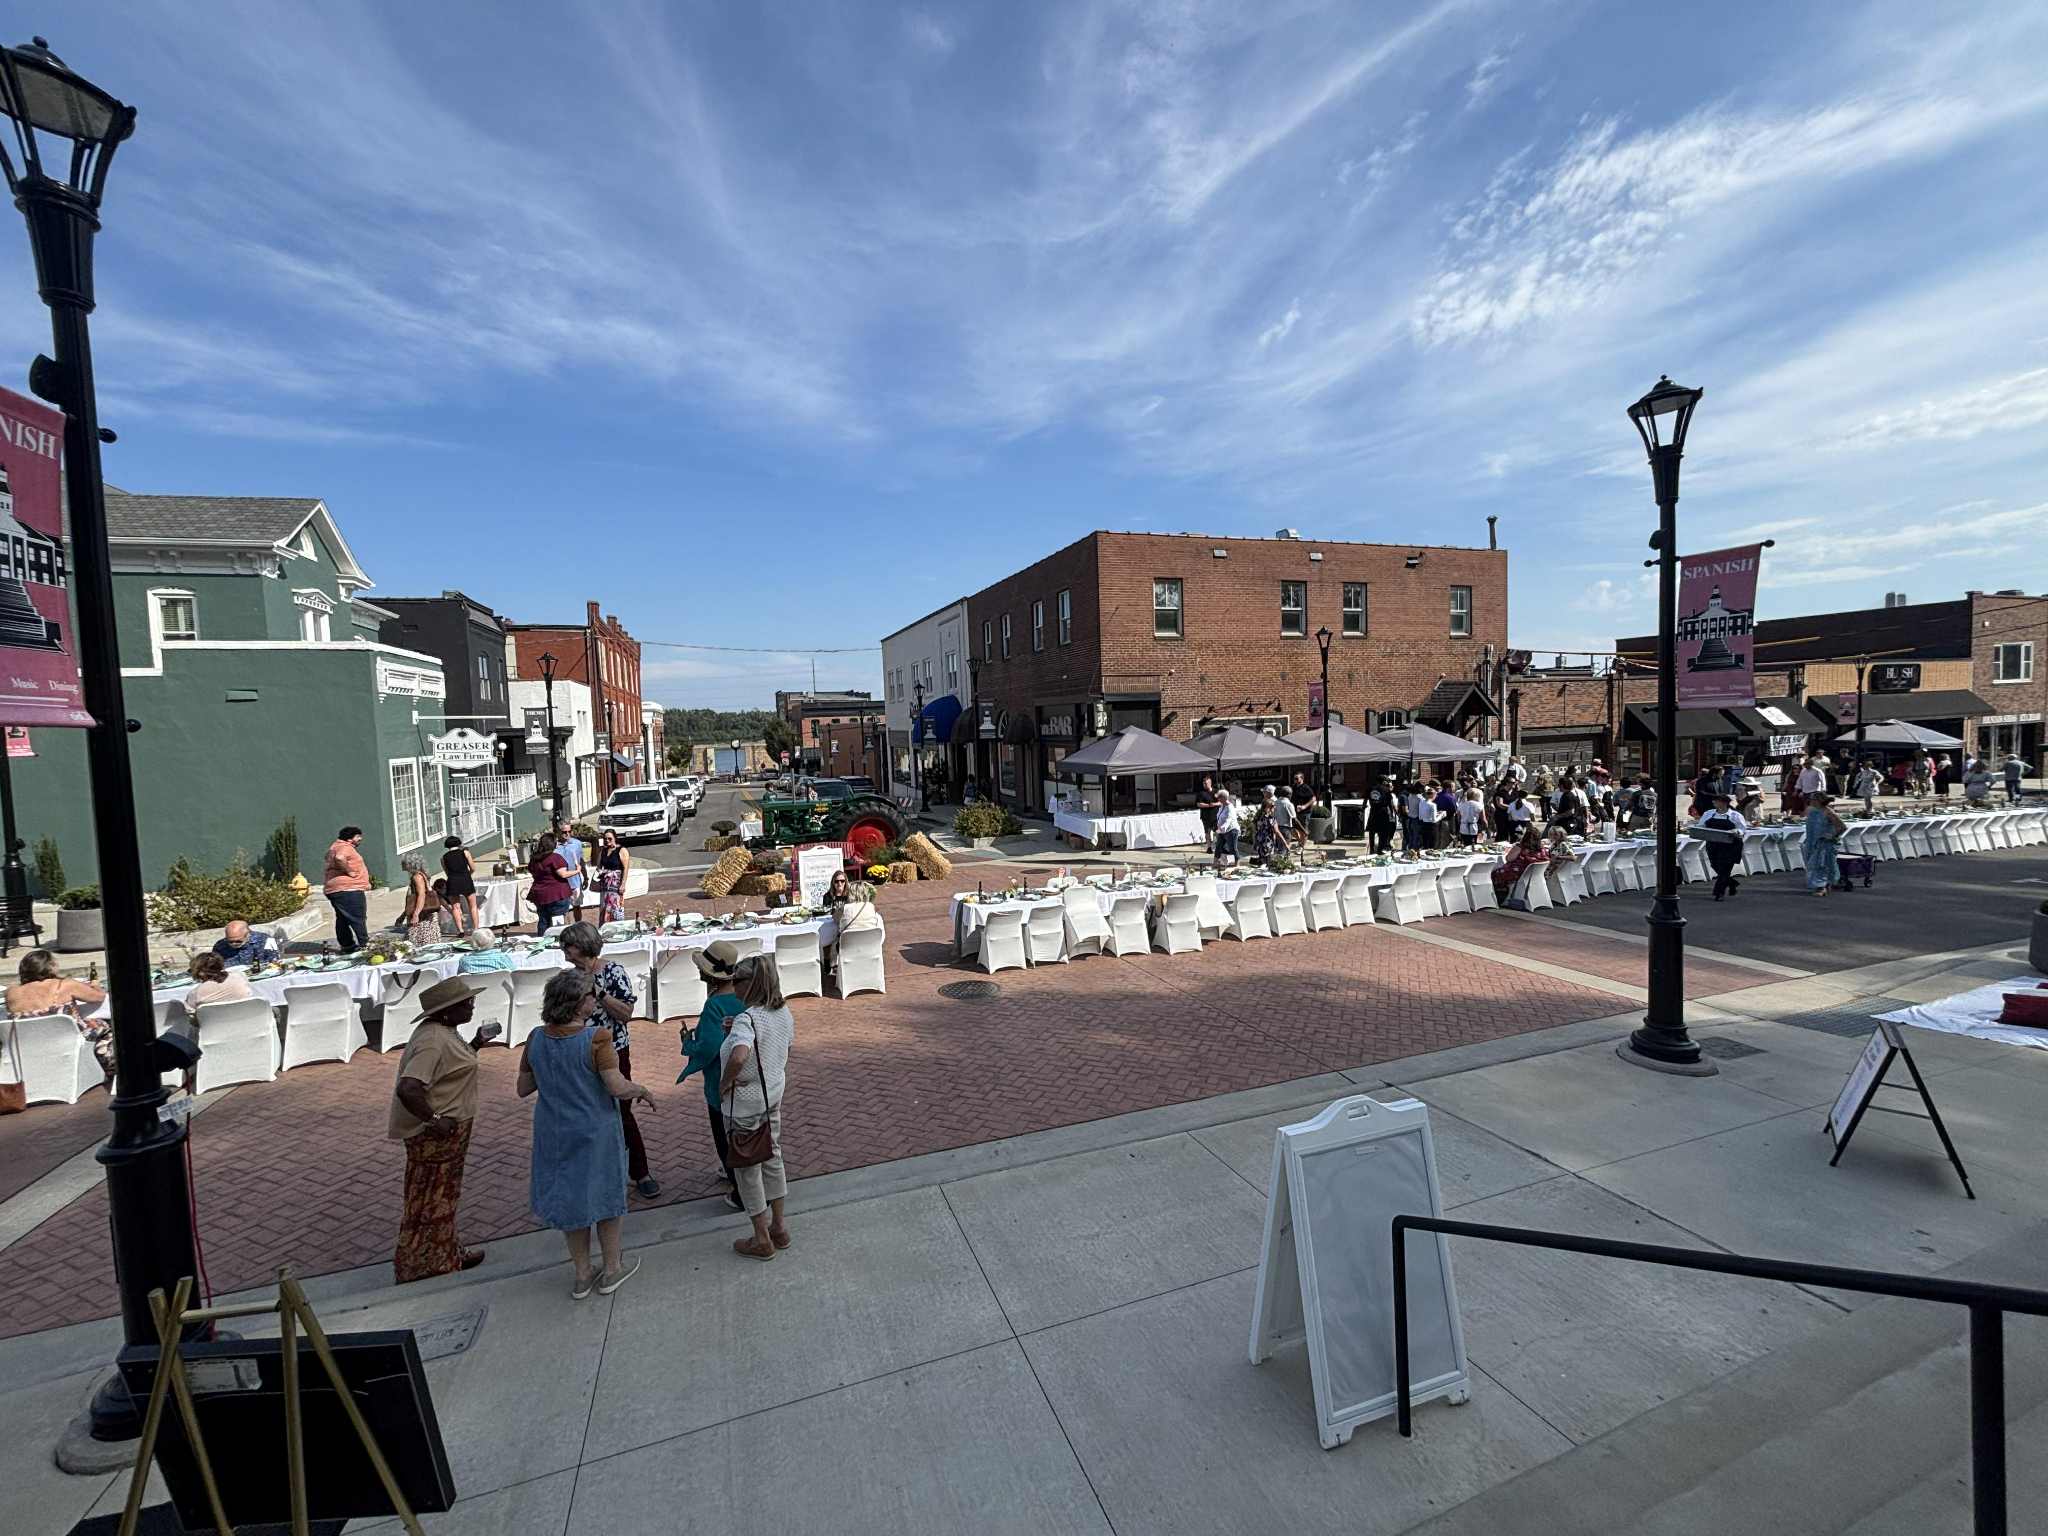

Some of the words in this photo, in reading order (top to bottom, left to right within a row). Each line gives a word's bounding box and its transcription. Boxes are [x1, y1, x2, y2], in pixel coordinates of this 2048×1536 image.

[1684, 558, 1753, 579] SPANISH
[1886, 667, 1913, 679] BLSH
[10, 677, 40, 689] Music
[48, 680, 79, 695] Dining
[436, 742, 490, 751] GREASER
[463, 752, 485, 760] Firm
